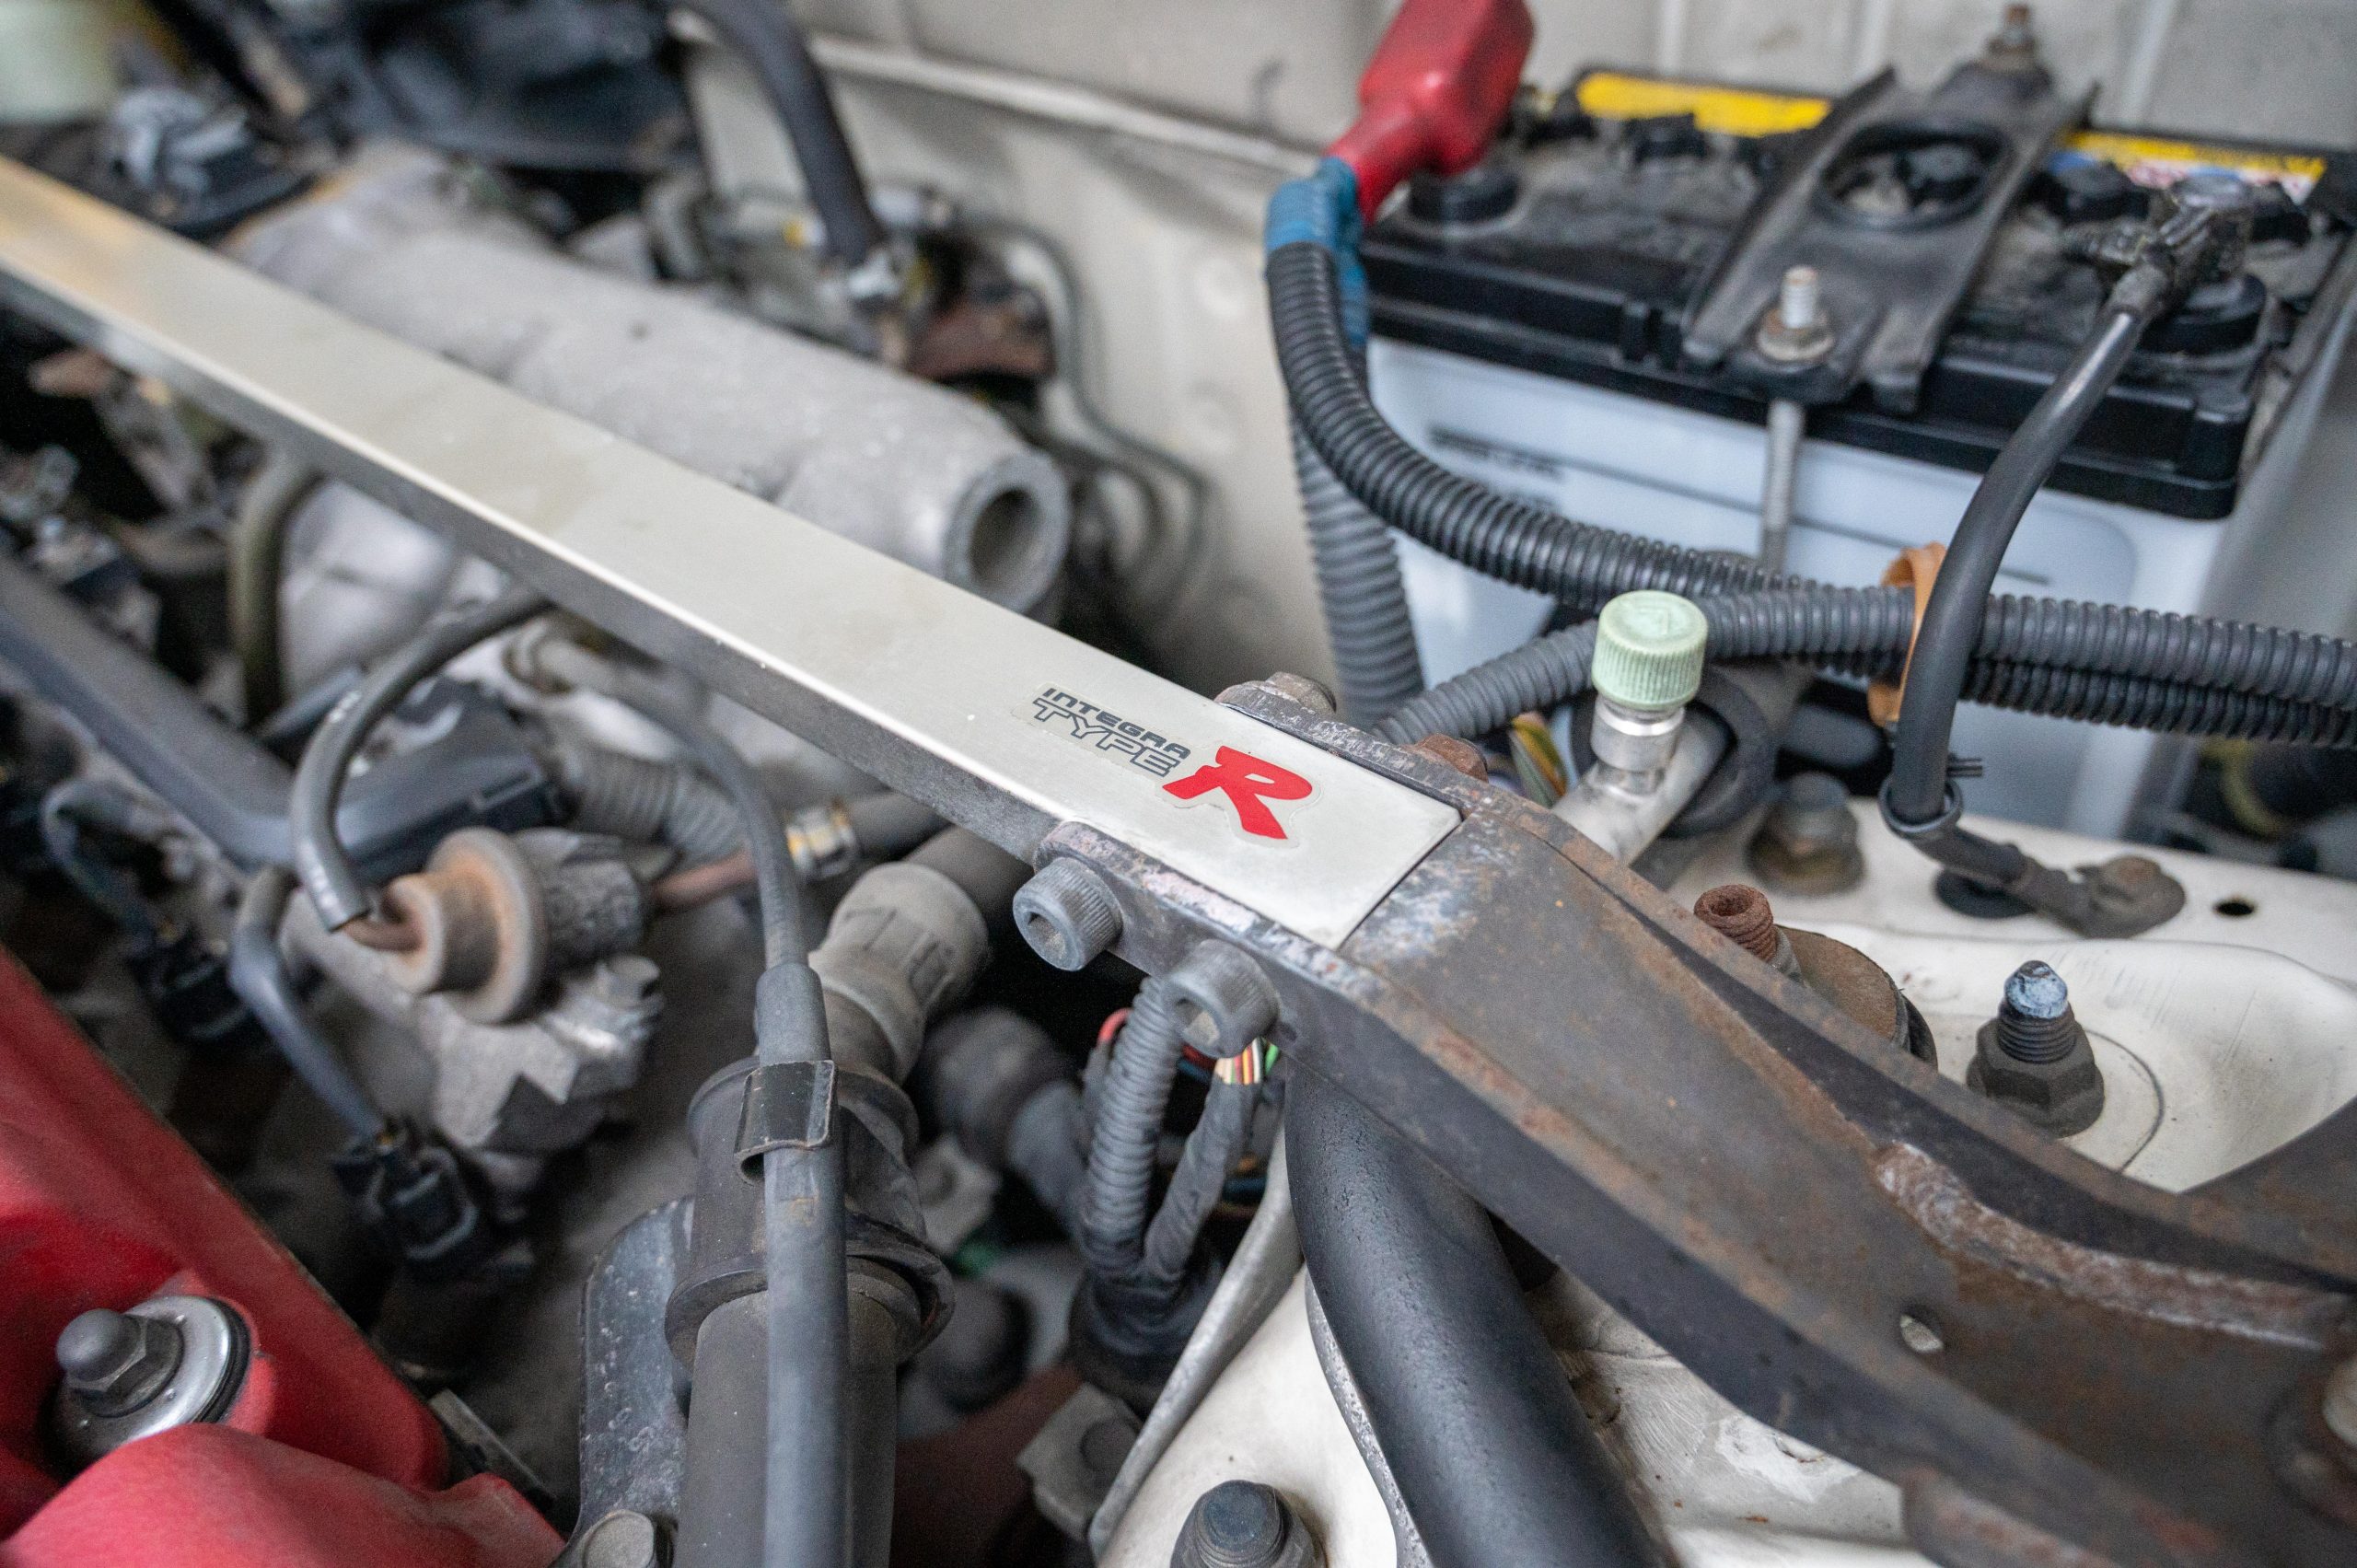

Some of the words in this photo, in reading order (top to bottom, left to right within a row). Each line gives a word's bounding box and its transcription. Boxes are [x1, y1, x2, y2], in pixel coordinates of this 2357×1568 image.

[1032, 697, 1180, 778] TYPE
[1162, 746, 1313, 840] R
[1041, 688, 1191, 760] INTEGRA
